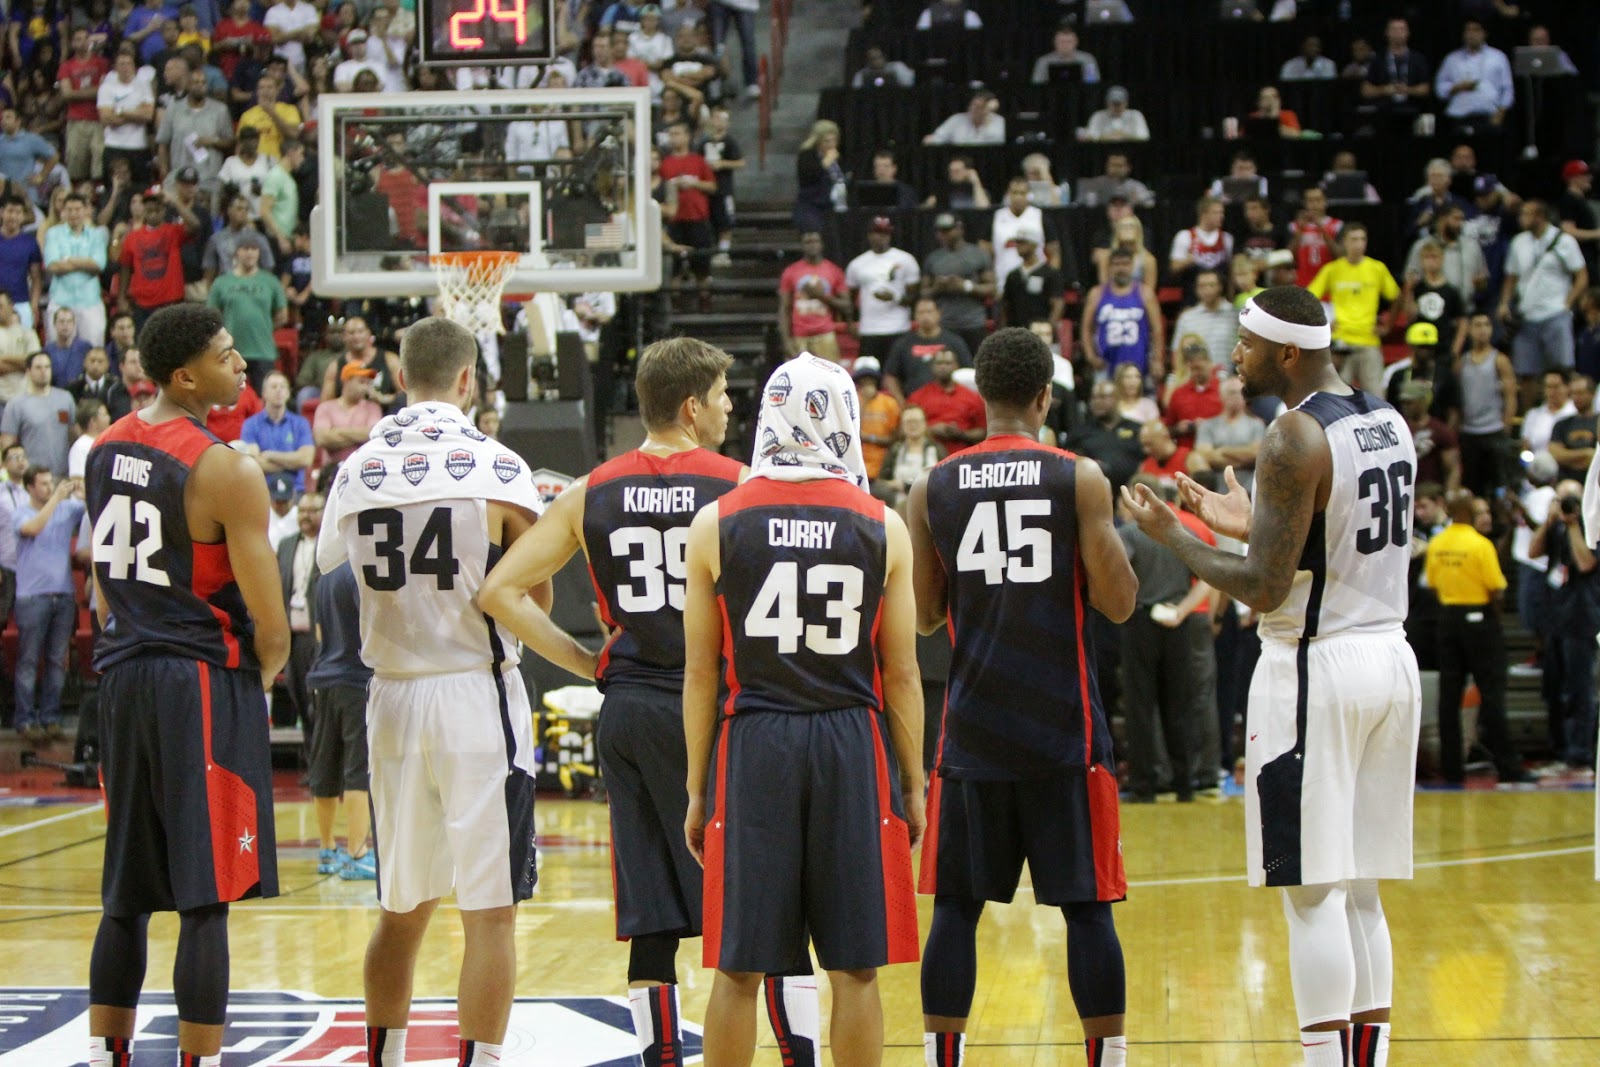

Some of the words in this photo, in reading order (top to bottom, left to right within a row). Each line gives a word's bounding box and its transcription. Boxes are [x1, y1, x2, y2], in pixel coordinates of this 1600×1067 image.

[450, 0, 527, 49] 24
[1106, 320, 1139, 346] 23
[111, 453, 152, 488] DAVIS
[624, 486, 695, 513] KORVER
[959, 461, 1041, 489] DeROZAN
[92, 494, 171, 586] 42
[768, 518, 837, 550] CURRY
[1356, 460, 1412, 555] 36
[358, 507, 459, 591] 34
[609, 526, 690, 613] 39
[956, 499, 1052, 585] 45
[744, 562, 864, 655] 43
